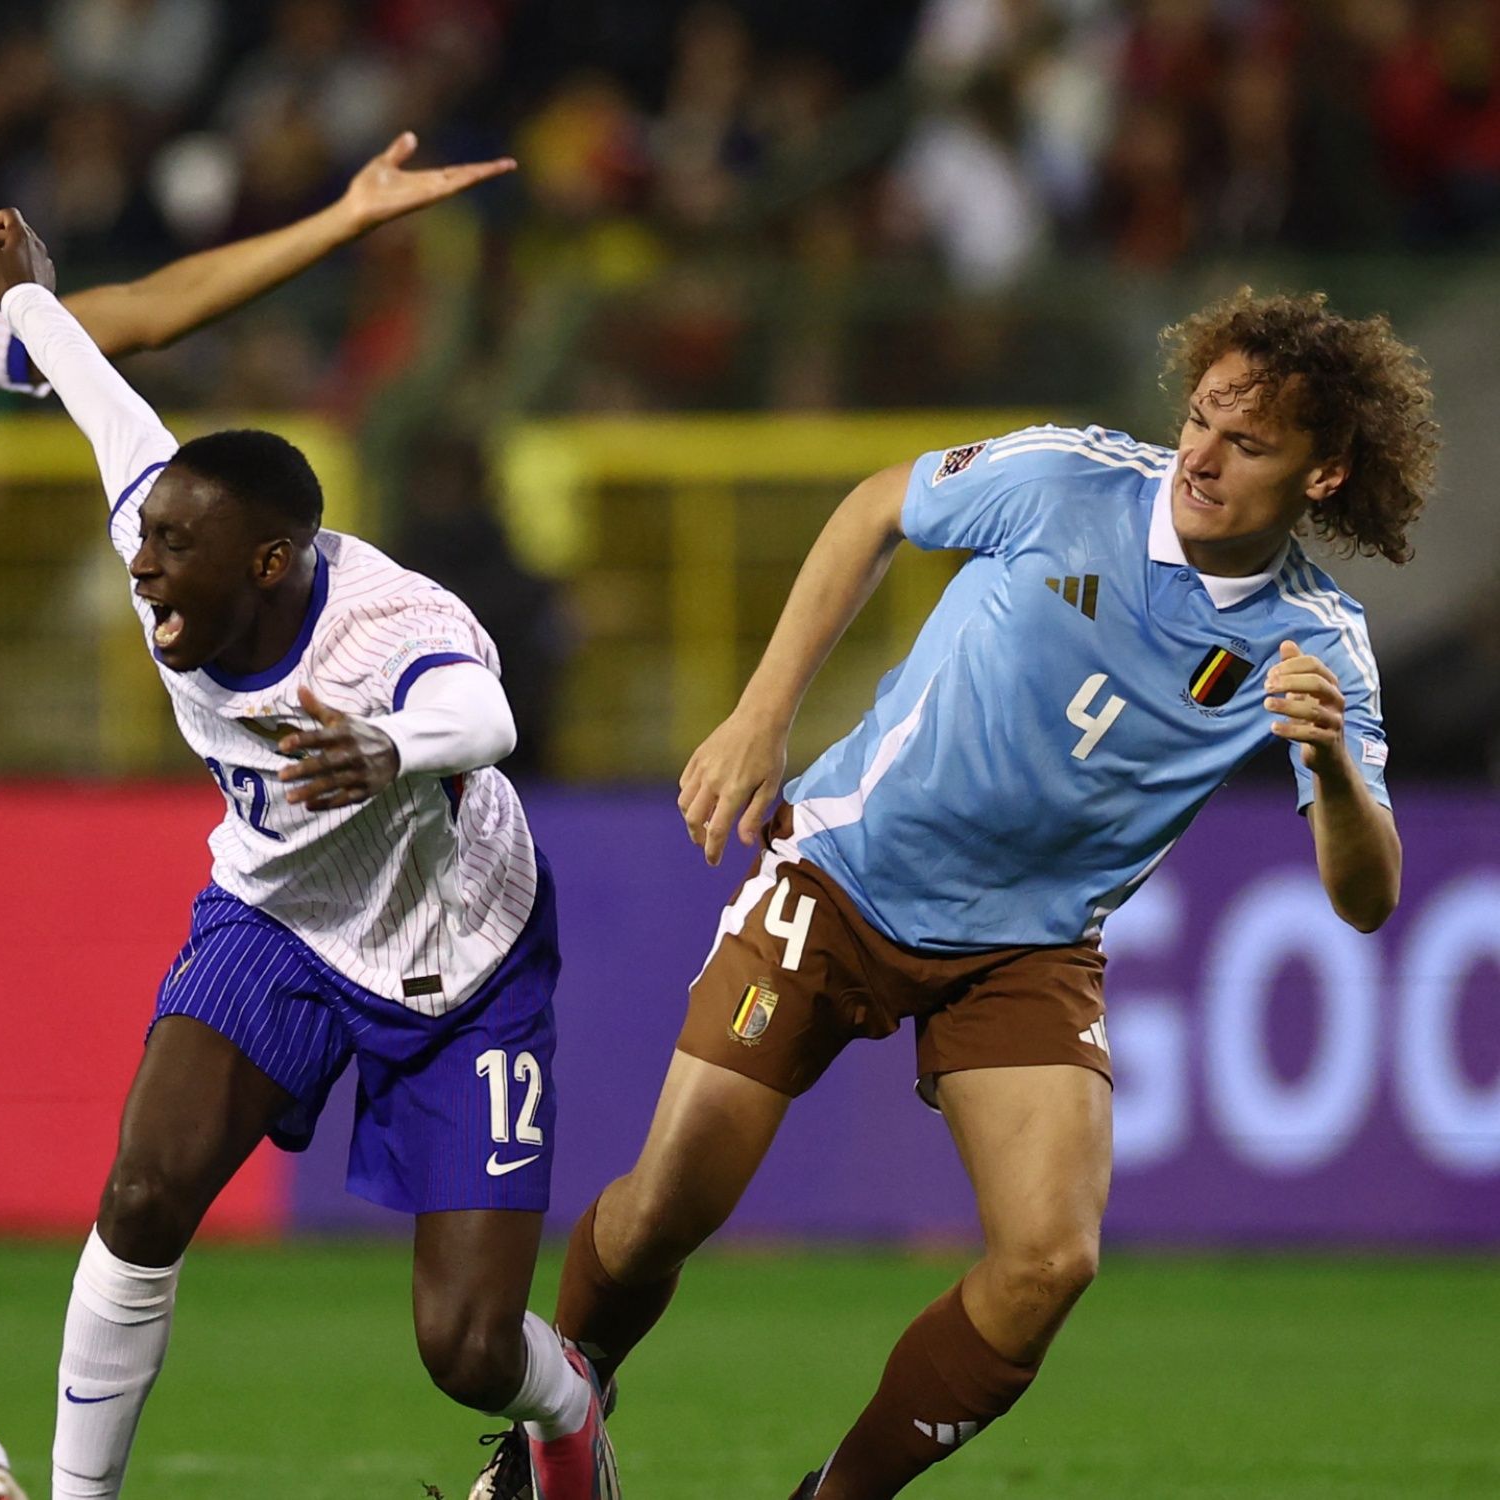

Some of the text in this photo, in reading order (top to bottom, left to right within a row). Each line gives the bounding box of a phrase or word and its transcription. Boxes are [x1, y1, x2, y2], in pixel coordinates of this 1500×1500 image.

[1066, 673, 1127, 761] 4
[764, 876, 817, 972] 4
[475, 1049, 543, 1146] 12
